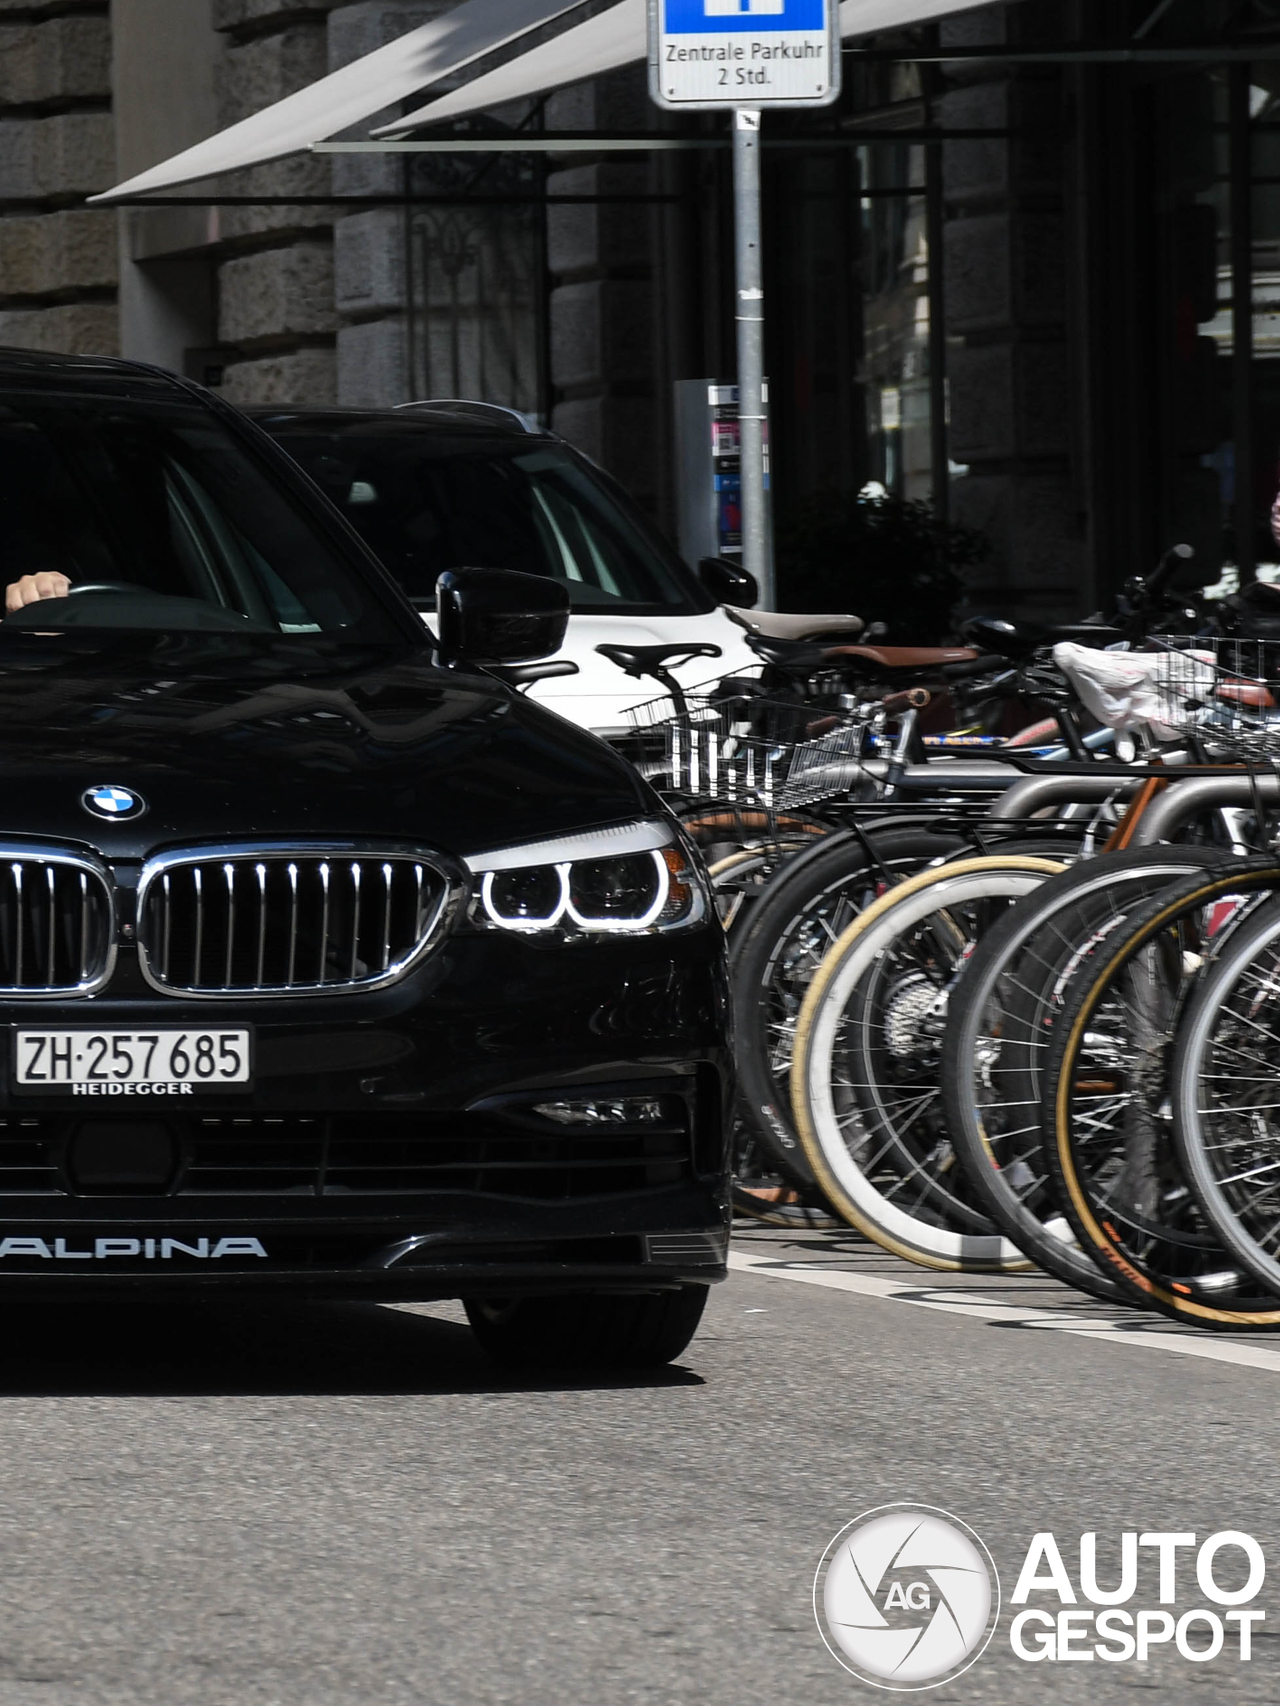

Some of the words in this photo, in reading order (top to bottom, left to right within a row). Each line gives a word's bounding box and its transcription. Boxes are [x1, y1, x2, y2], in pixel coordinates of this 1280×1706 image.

[666, 42, 743, 62] Zentrale
[751, 40, 824, 60] Parkuhr
[717, 68, 728, 85] 2
[735, 67, 772, 85] Std.
[72, 1083, 194, 1096] HEIDEGGER
